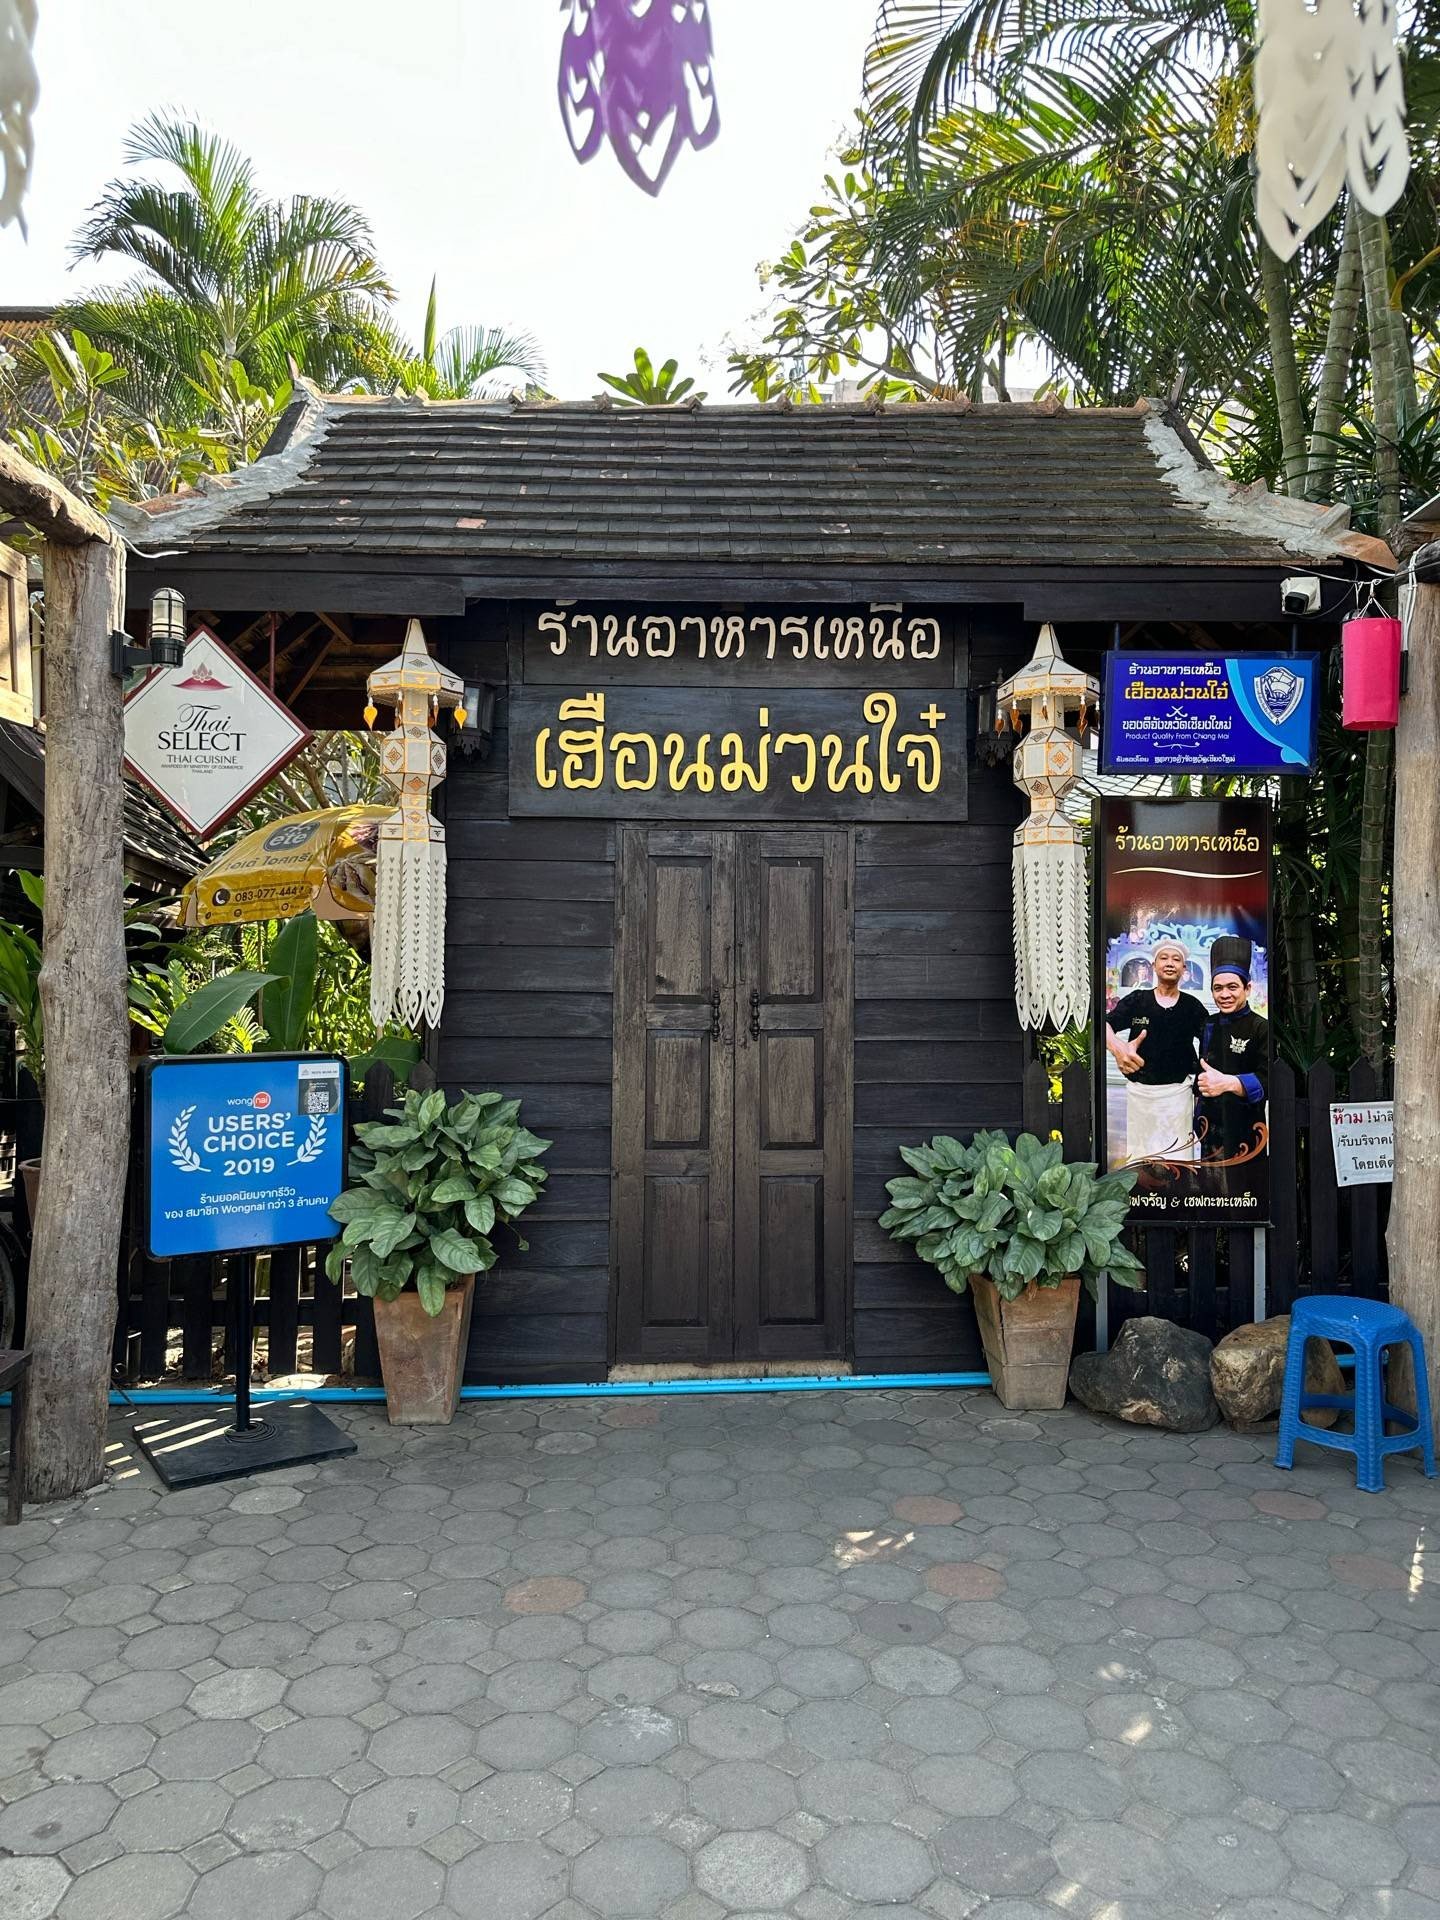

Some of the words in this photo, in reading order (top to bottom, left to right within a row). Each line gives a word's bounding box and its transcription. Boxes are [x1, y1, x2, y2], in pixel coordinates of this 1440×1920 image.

[538, 600, 941, 660] รานอาหารเหนอ
[1128, 662, 1222, 676] ร้านอาหารเหนือ
[1125, 679, 1229, 700] เฮือนม่วนใจ๋
[174, 703, 232, 732] Thai
[1122, 715, 1232, 730] ของดีจังหวัดเชียงใหม่
[158, 731, 247, 752] SELECT
[535, 691, 946, 794] เฮือนม่วนใจ๋
[1125, 732, 1150, 740] Product
[1152, 732, 1174, 741] Quality
[1175, 732, 1191, 740] From
[1192, 732, 1216, 741] Chiang
[1218, 732, 1229, 740] Mai
[166, 754, 192, 763] THAI
[194, 755, 239, 765] CUISINE
[1115, 825, 1260, 852] ร้านอาหารเหนือ
[227, 1095, 269, 1106] wongnai
[203, 1131, 295, 1153] CHOICE
[1337, 1133, 1394, 1148] /รับบริจาคเ
[223, 1157, 275, 1177] 2019
[200, 1187, 296, 1205] ร้านยอดนิยมจากรีวิว
[1170, 1196, 1180, 1208] &
[1184, 1192, 1258, 1208] เชฟกะทะเหล็ก
[165, 1209, 183, 1220] ของ
[185, 1206, 219, 1218] สมาชิก
[222, 1202, 265, 1215] Wongnai
[267, 1198, 286, 1209] กว่า
[288, 1199, 294, 1208] 3
[296, 1195, 329, 1208] ล้านคน
